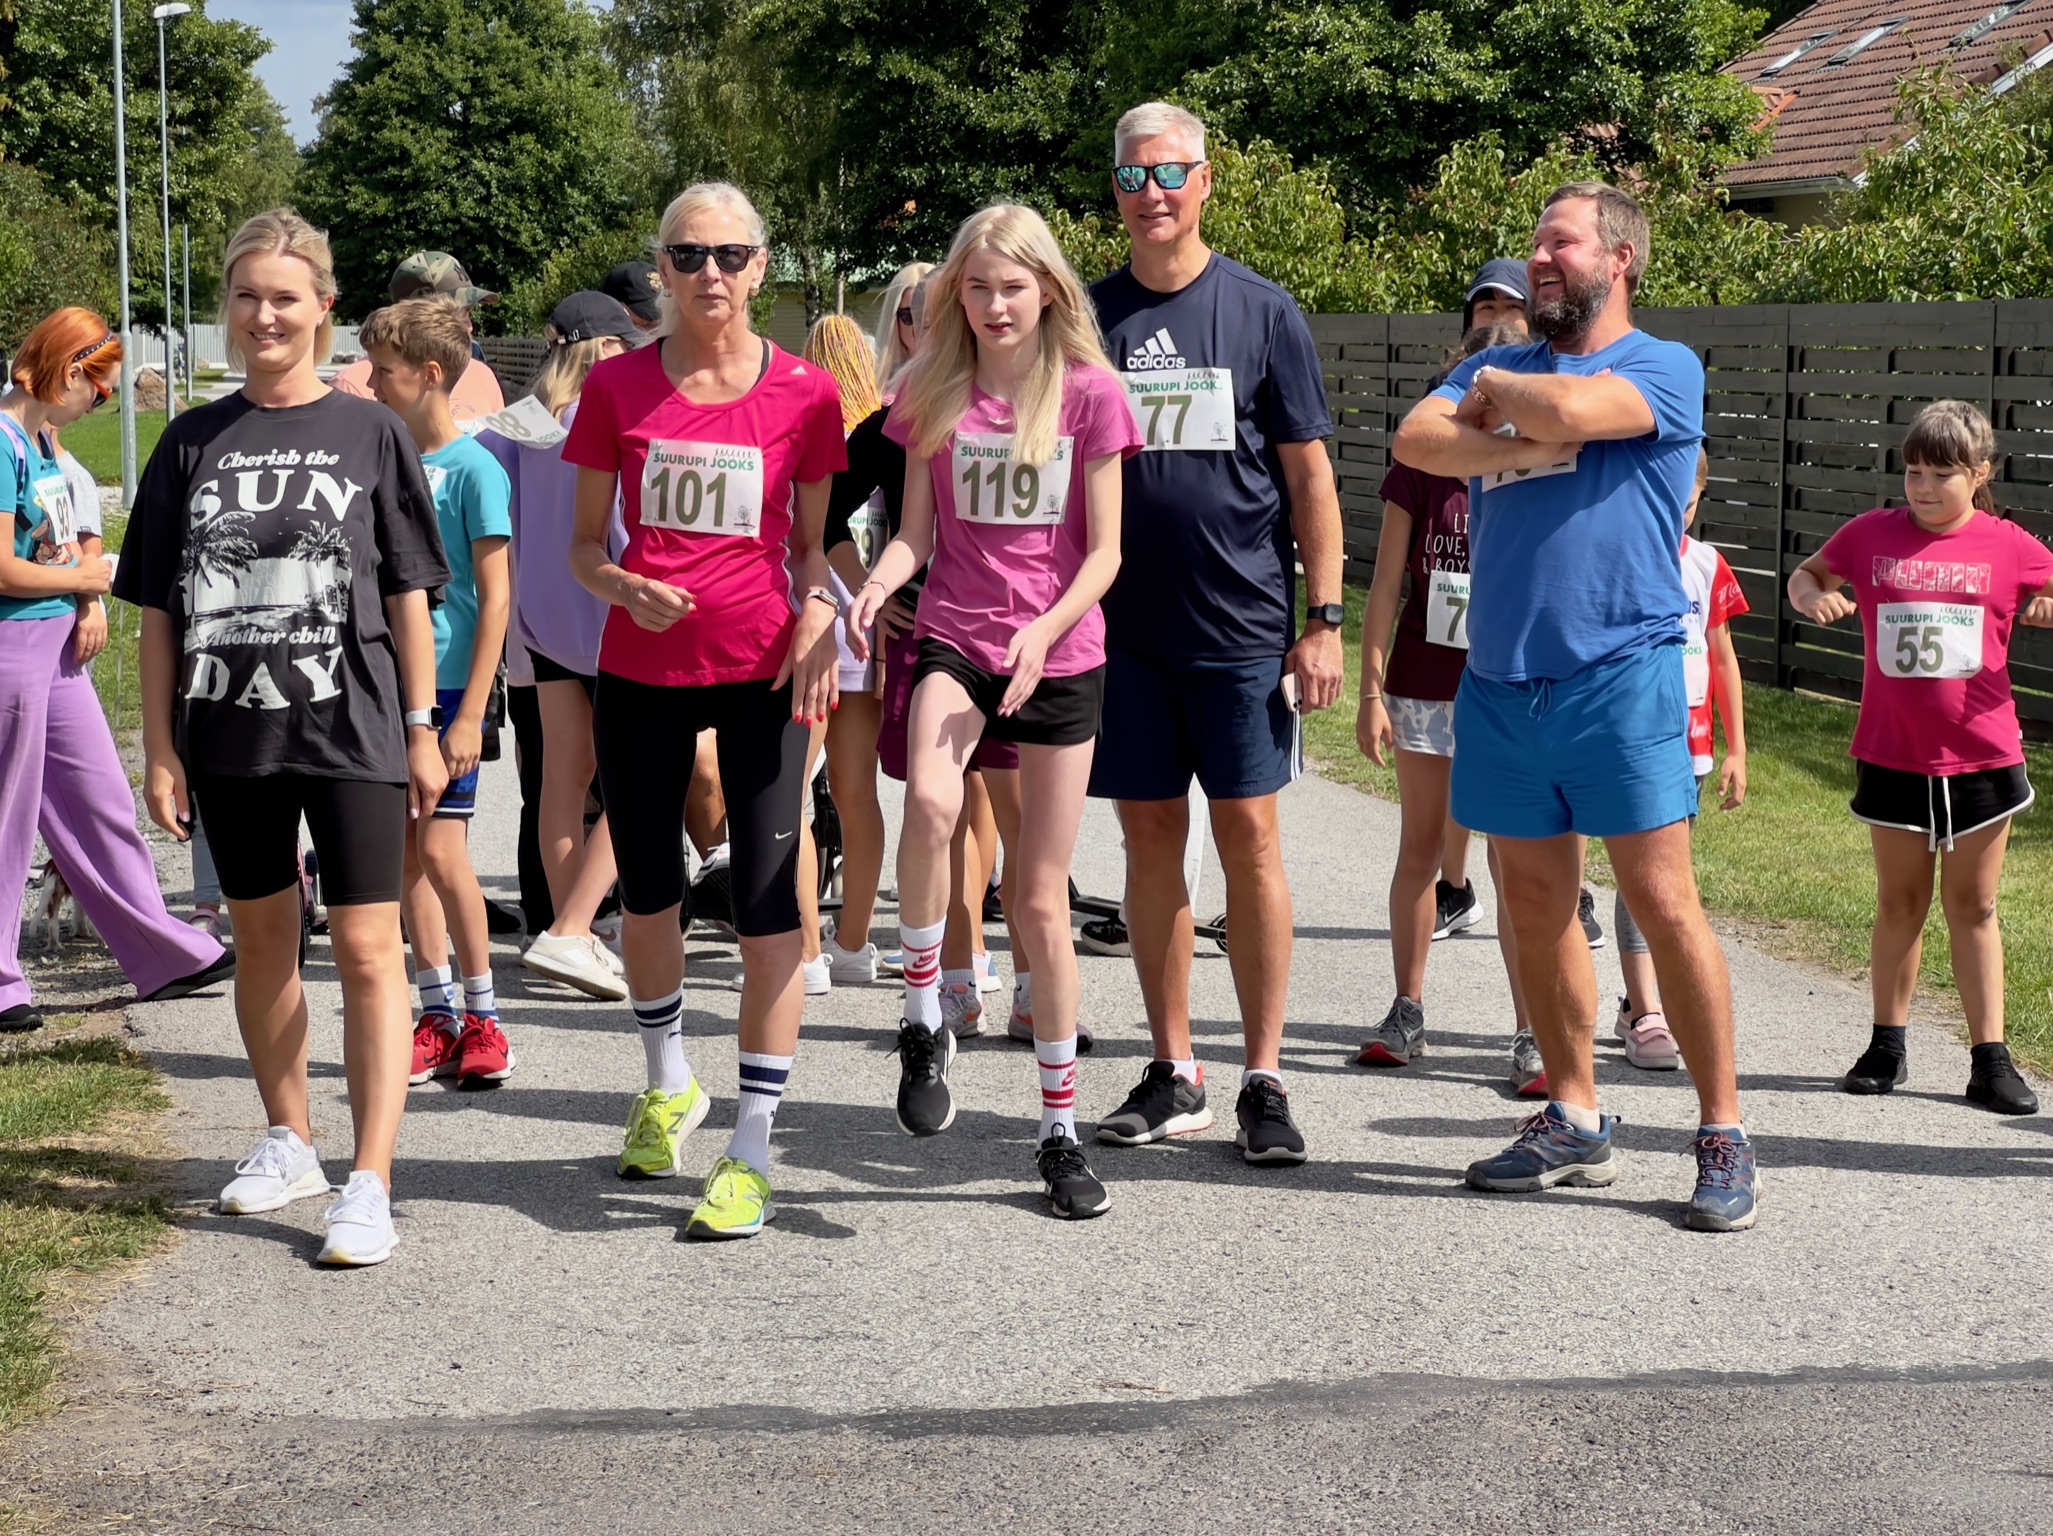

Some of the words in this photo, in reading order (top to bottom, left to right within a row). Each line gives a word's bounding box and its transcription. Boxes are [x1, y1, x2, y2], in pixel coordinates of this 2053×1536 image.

[1127, 354, 1186, 369] adidas
[1129, 382, 1180, 394] SUURUPI
[1184, 380, 1222, 391] JOOK
[1141, 394, 1192, 446] 77
[217, 449, 301, 470] Cherish
[305, 450, 339, 465] the
[653, 452, 707, 467] SUURUPI
[710, 457, 754, 471] JOOKS
[961, 446, 1012, 459] SUURUP
[190, 469, 363, 531] SUN
[650, 466, 727, 527] 101
[962, 460, 1039, 519] 119
[55, 495, 70, 540] 93
[1437, 583, 1471, 595] SUURU
[1872, 555, 1991, 595] PUMA
[1885, 613, 1933, 624] SUURUPI
[1936, 615, 1975, 627] JOOKS
[200, 626, 287, 649] Another
[288, 625, 336, 645] chill
[1895, 625, 1944, 674] 55
[185, 645, 343, 709] DAY
